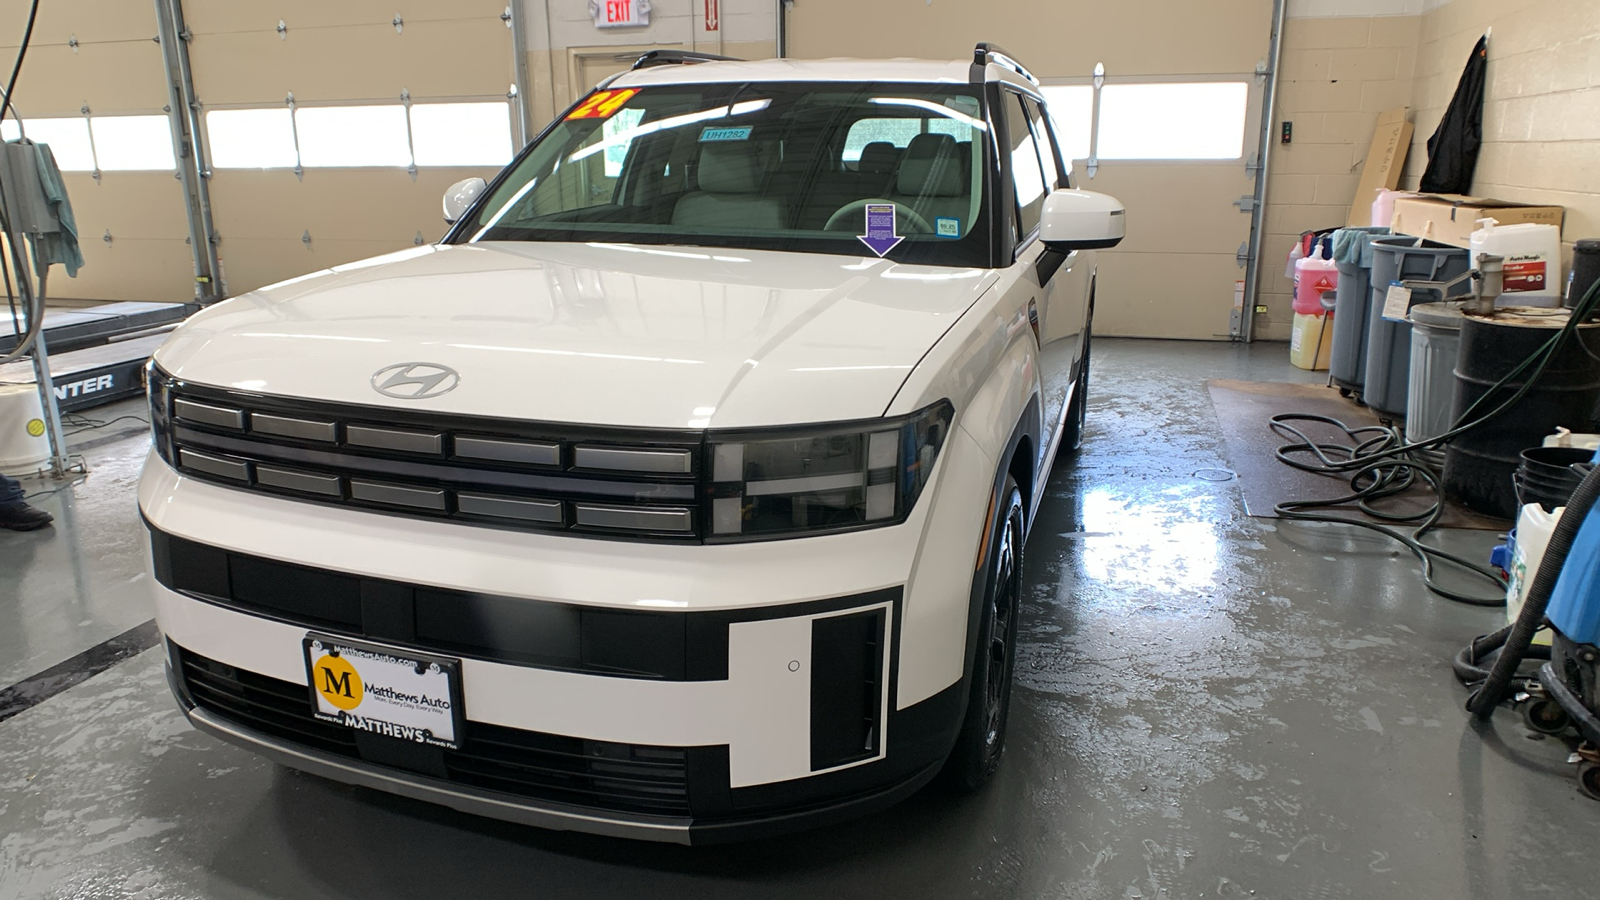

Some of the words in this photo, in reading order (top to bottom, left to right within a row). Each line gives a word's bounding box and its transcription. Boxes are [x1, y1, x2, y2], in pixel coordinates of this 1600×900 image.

[606, 0, 631, 22] EXIT
[568, 89, 635, 119] 24
[706, 130, 745, 139] UH1282
[53, 374, 113, 400] NTER
[334, 645, 418, 668] MatthewsAuto.com
[321, 667, 355, 699] M
[364, 682, 419, 704] Matthews
[420, 694, 450, 710] Auto
[345, 715, 424, 743] MATTHEWS
